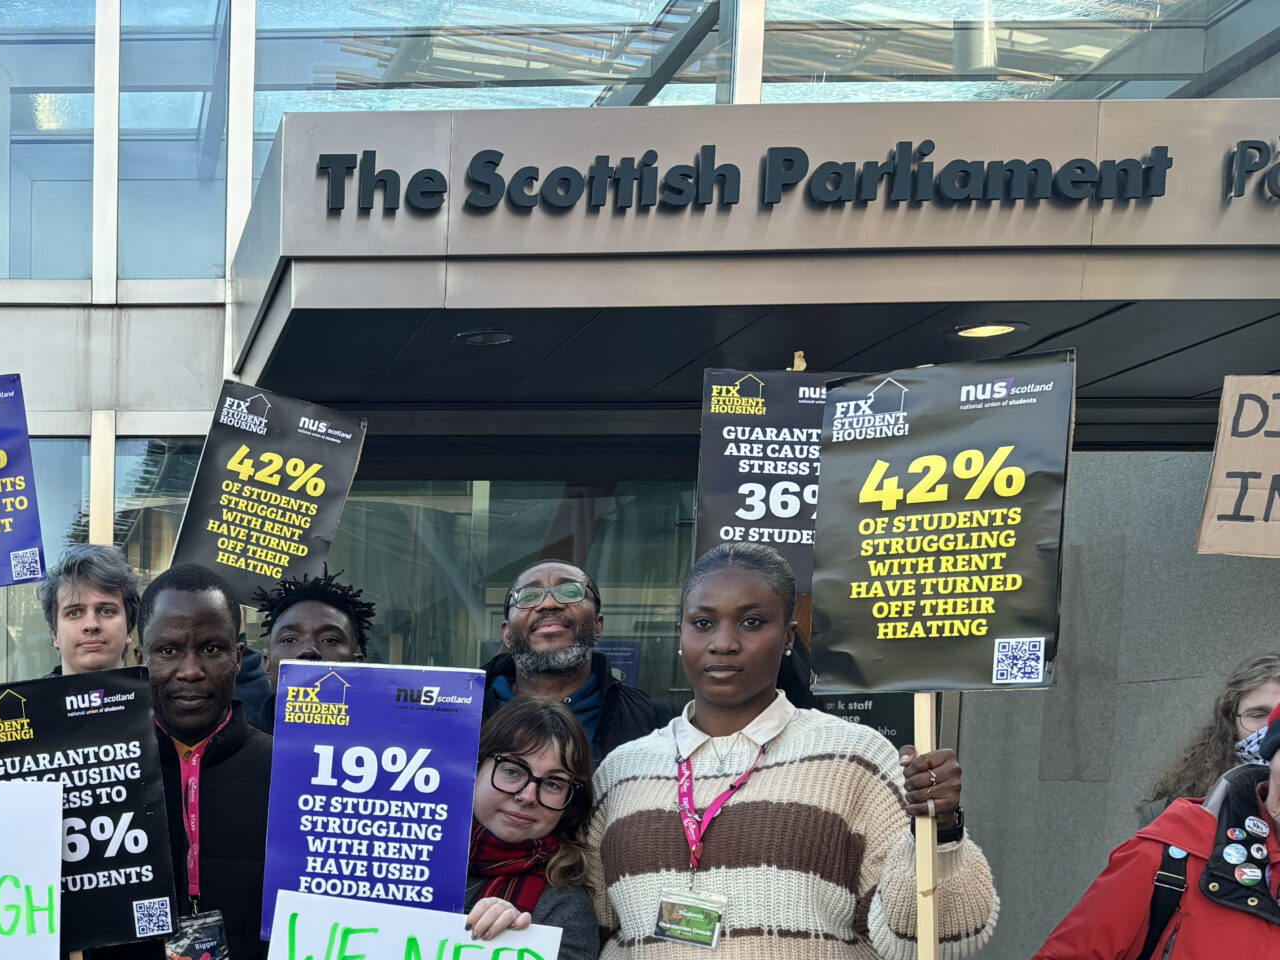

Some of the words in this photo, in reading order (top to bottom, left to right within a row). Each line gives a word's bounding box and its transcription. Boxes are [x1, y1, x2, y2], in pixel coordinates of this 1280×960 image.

[318, 150, 448, 210] The
[465, 144, 740, 209] Scottish
[764, 139, 1173, 204] Parliament
[711, 385, 740, 397] FIX
[711, 396, 764, 407] STUDENT
[960, 382, 1008, 401] nus
[1010, 382, 1054, 394] scotland
[223, 396, 250, 412] FIX
[710, 406, 766, 416] HOUSING!
[834, 400, 873, 418] FIX
[960, 402, 984, 410] national
[1008, 398, 1036, 406] students
[220, 415, 267, 436] HOUSING!
[221, 408, 268, 426] STUDENT
[832, 412, 908, 430] STUDENT
[299, 416, 327, 434] nus
[327, 428, 352, 440] scotland
[722, 426, 821, 442] GUARANT
[832, 424, 909, 442] HOUSING!
[724, 444, 763, 457] ARE
[767, 445, 821, 458] CAUS
[226, 444, 326, 497] 42%
[739, 460, 810, 475] STRESS
[858, 446, 1026, 511] 42%
[2, 496, 28, 510] TO
[222, 480, 240, 493] OF
[242, 485, 318, 516] STUDENTS
[220, 495, 312, 529] STRUGGLING
[858, 518, 889, 536] OF
[892, 508, 1022, 534] STUDENTS
[222, 509, 262, 528] WITH
[263, 520, 303, 540] RENT
[720, 526, 745, 541] OF
[207, 520, 248, 540] HAVE
[250, 532, 308, 557] TURNED
[860, 530, 1016, 556] STRUGGLING
[218, 538, 245, 554] OFF
[246, 544, 290, 566] THEIR
[216, 551, 283, 579] HEATING
[868, 556, 936, 577] WITH
[938, 552, 1006, 573] RENT
[850, 580, 916, 599] HAVE
[920, 574, 1023, 595] TURNED
[872, 600, 916, 619] OFF
[920, 596, 996, 618] THEIR
[877, 619, 988, 640] HEATING
[66, 692, 102, 710] nus
[104, 692, 134, 704] scotland
[286, 686, 320, 702] FIX
[396, 686, 438, 706] nus
[438, 694, 472, 704] scotland
[285, 702, 348, 716] STUDENT
[848, 700, 872, 710] staff
[284, 712, 350, 726] HOUSING!
[310, 744, 440, 794] 19%
[96, 786, 126, 806] TO
[298, 794, 326, 811] OF
[330, 796, 448, 821] STUDENTS
[62, 812, 148, 863] 6%
[300, 816, 442, 842] STRUGGLING
[306, 836, 370, 856] WITH
[372, 842, 433, 861] RENT
[306, 856, 368, 877] HAVE
[372, 862, 430, 882] USED
[298, 876, 433, 902] FOODBANKS
